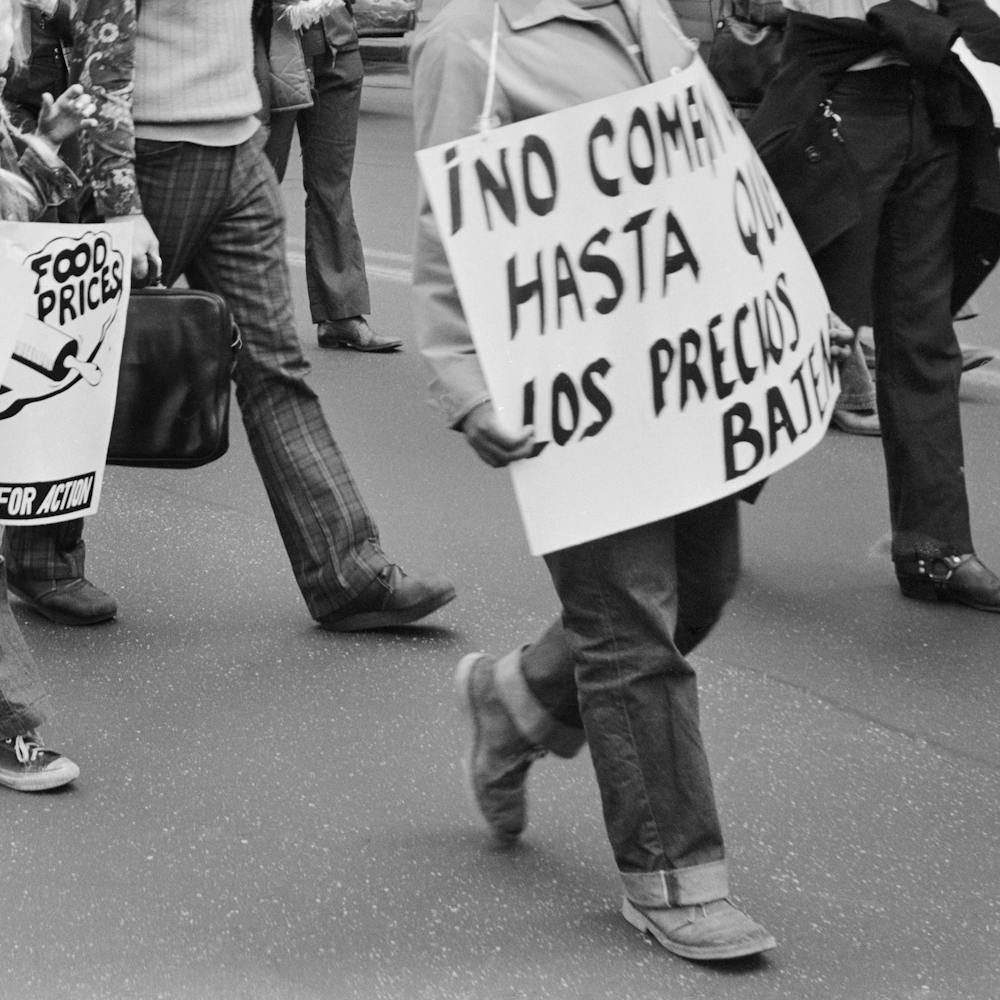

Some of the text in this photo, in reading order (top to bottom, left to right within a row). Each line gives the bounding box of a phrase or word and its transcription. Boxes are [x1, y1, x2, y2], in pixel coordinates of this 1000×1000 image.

[31, 237, 107, 295] FOOD
[38, 260, 121, 326] PRICES
[506, 207, 701, 341] HASTA
[521, 272, 801, 460] LOS PRECIOS
[35, 475, 94, 515] ACTION
